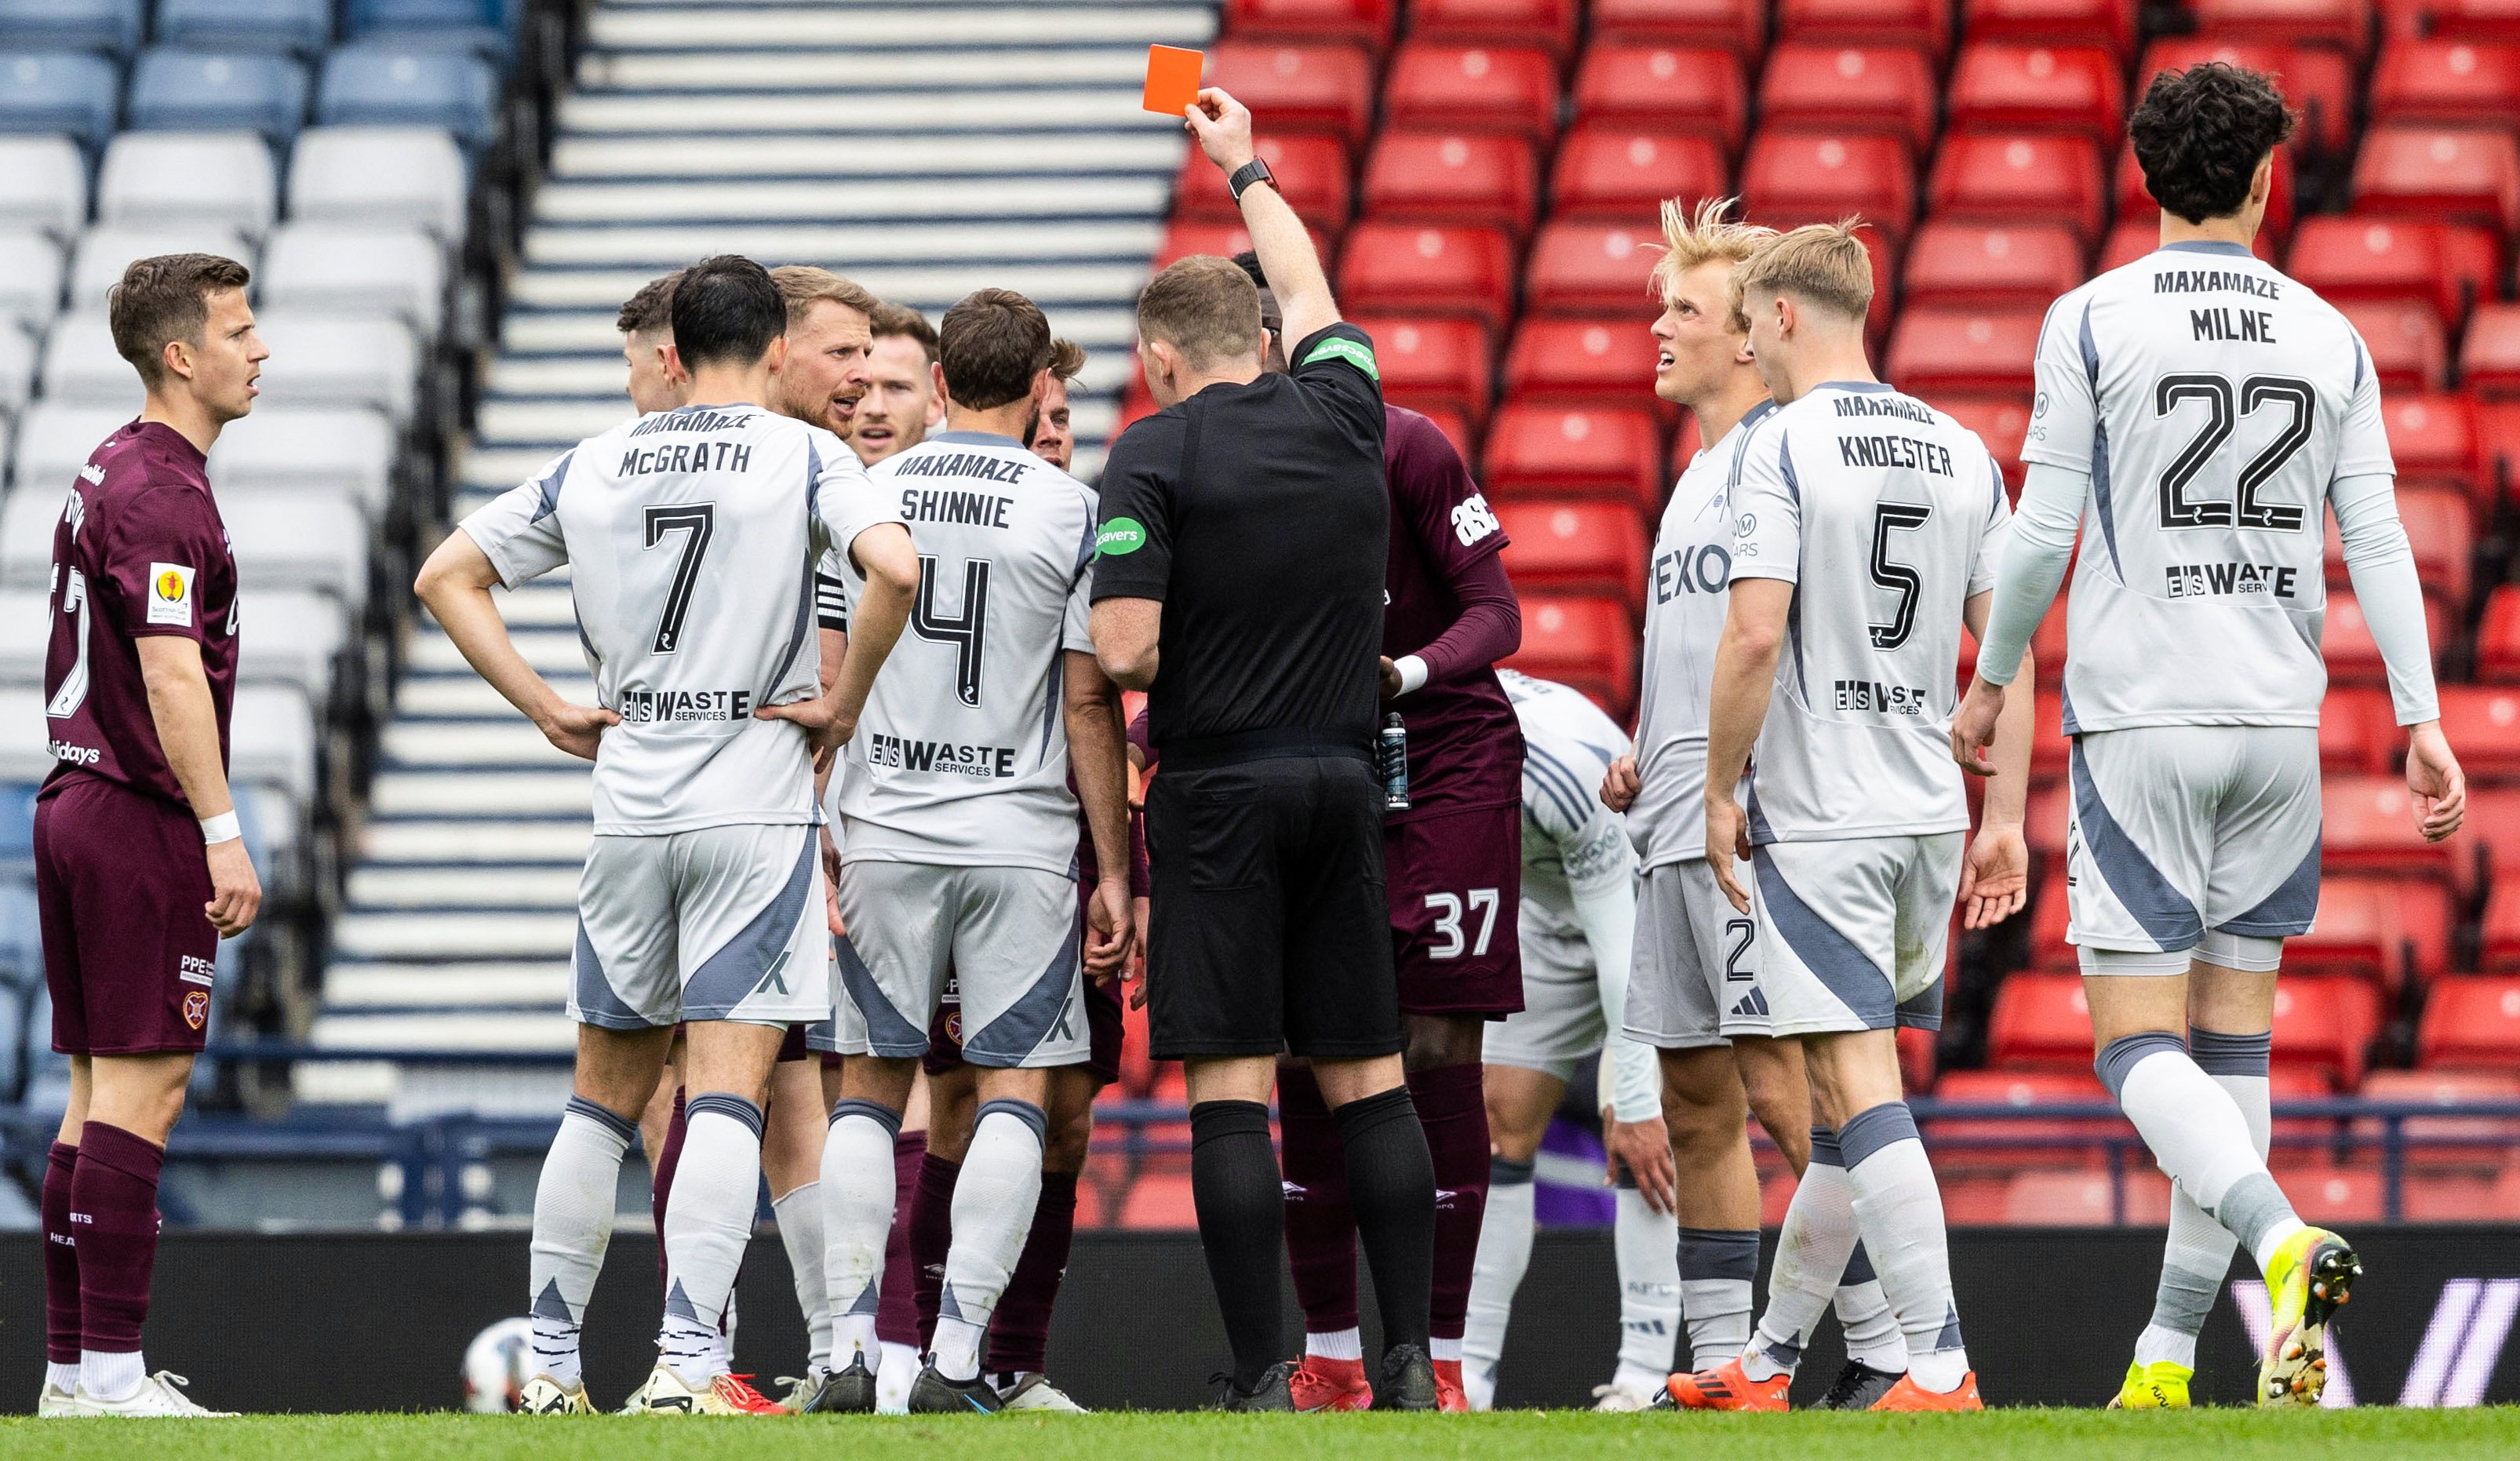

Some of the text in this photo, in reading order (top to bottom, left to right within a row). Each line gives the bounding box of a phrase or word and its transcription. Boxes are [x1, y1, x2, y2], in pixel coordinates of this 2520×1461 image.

[2154, 271, 2279, 301] MAXAMAZE
[2190, 308, 2276, 344] MILNE
[1307, 344, 1376, 373] Specsaver
[617, 442, 752, 477] McGRATH
[1837, 435, 1954, 478] KNOESTER
[2153, 372, 2318, 534] 22
[900, 489, 1014, 530] SHINNIE
[643, 501, 716, 656] 7
[1650, 545, 1732, 605] EXO
[1870, 500, 1933, 652] 5
[2166, 563, 2297, 598] EIS WATE
[910, 554, 992, 709] 4
[656, 690, 750, 721] WASTE
[1834, 680, 1870, 711] EIS
[675, 712, 727, 721] SERVICES
[47, 740, 100, 765] lidays
[869, 734, 1015, 778] EIS WASTE
[934, 763, 992, 777] SERVICES
[1425, 887, 1499, 960] 37
[181, 955, 206, 974] PPE
[1726, 918, 1755, 982] 2
